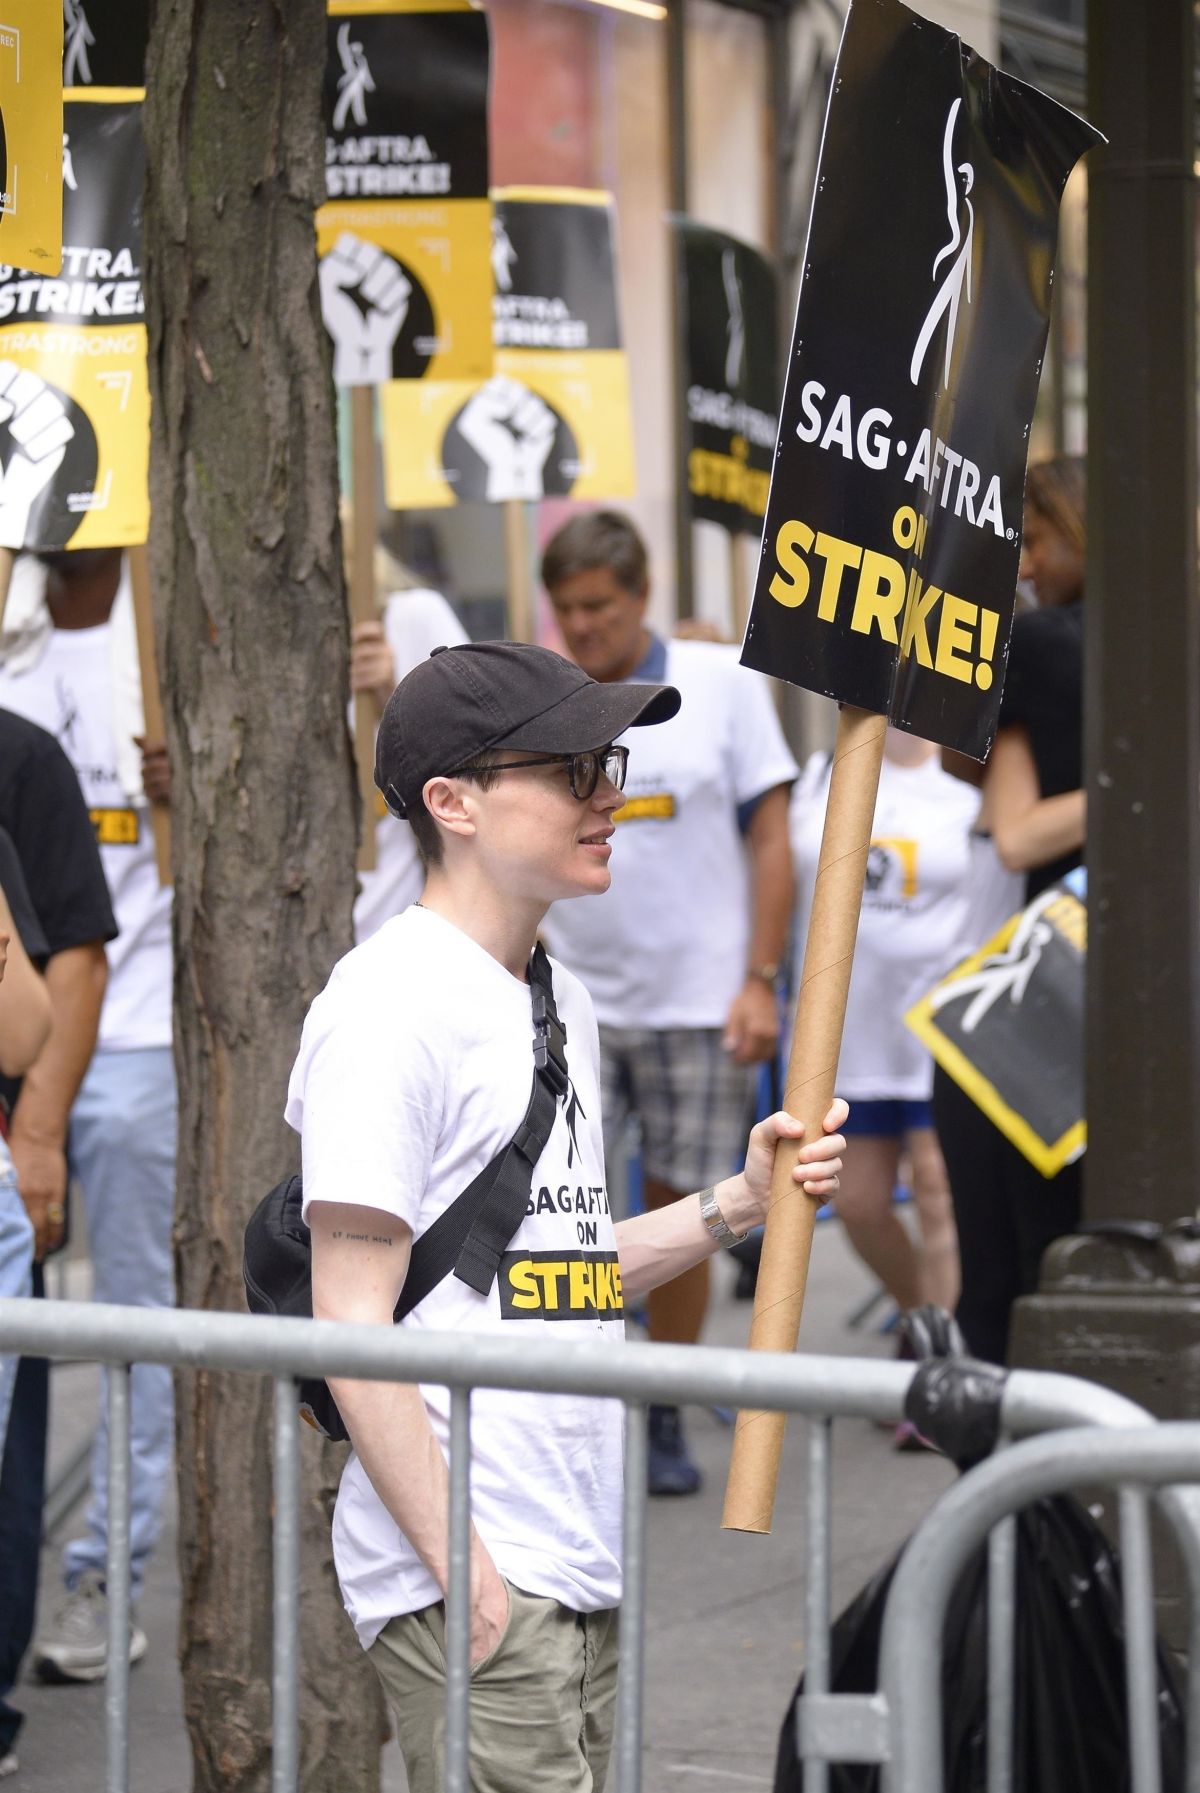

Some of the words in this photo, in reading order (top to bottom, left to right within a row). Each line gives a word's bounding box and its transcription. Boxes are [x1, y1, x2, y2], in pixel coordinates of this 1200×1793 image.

[892, 506, 928, 560] ON
[769, 520, 1000, 691] STRIKE!
[576, 1221, 597, 1245] ON
